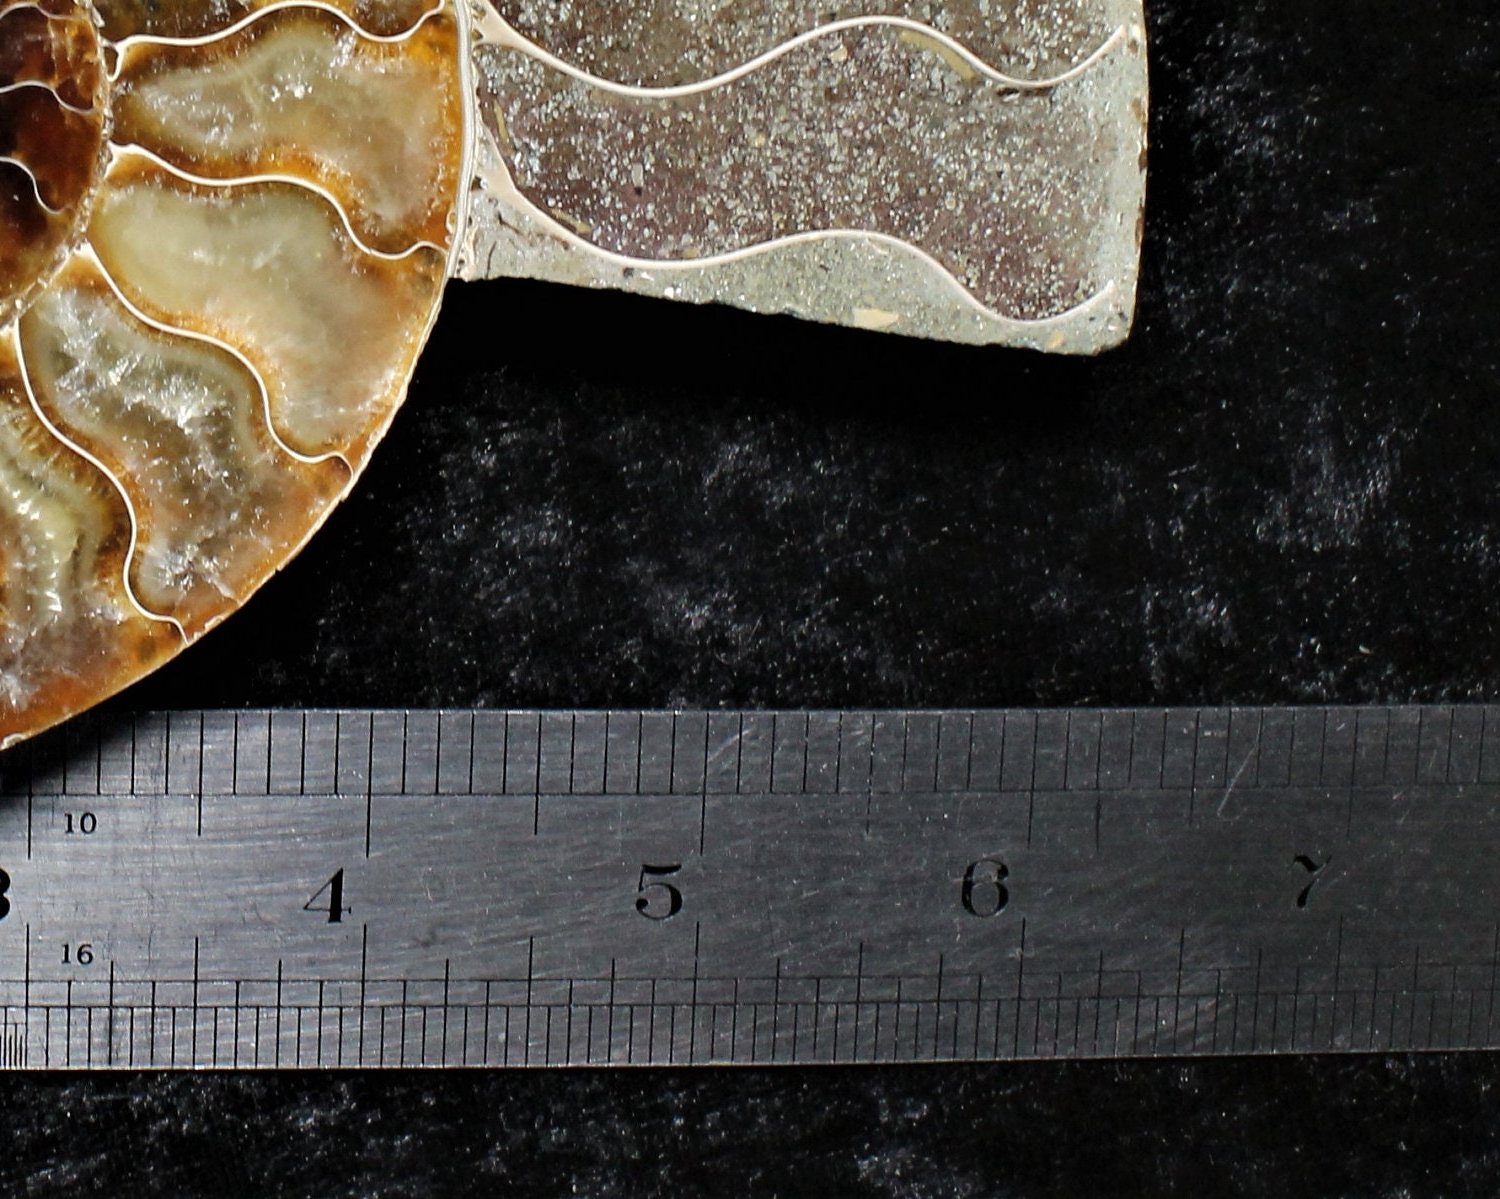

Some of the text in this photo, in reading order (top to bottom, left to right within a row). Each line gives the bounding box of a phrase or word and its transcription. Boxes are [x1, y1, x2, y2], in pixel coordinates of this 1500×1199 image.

[64, 812, 98, 835] 10
[303, 867, 352, 923] 4
[635, 863, 683, 920] 5
[961, 858, 1009, 918] 6
[1291, 854, 1332, 909] 7
[60, 943, 94, 965] 16
